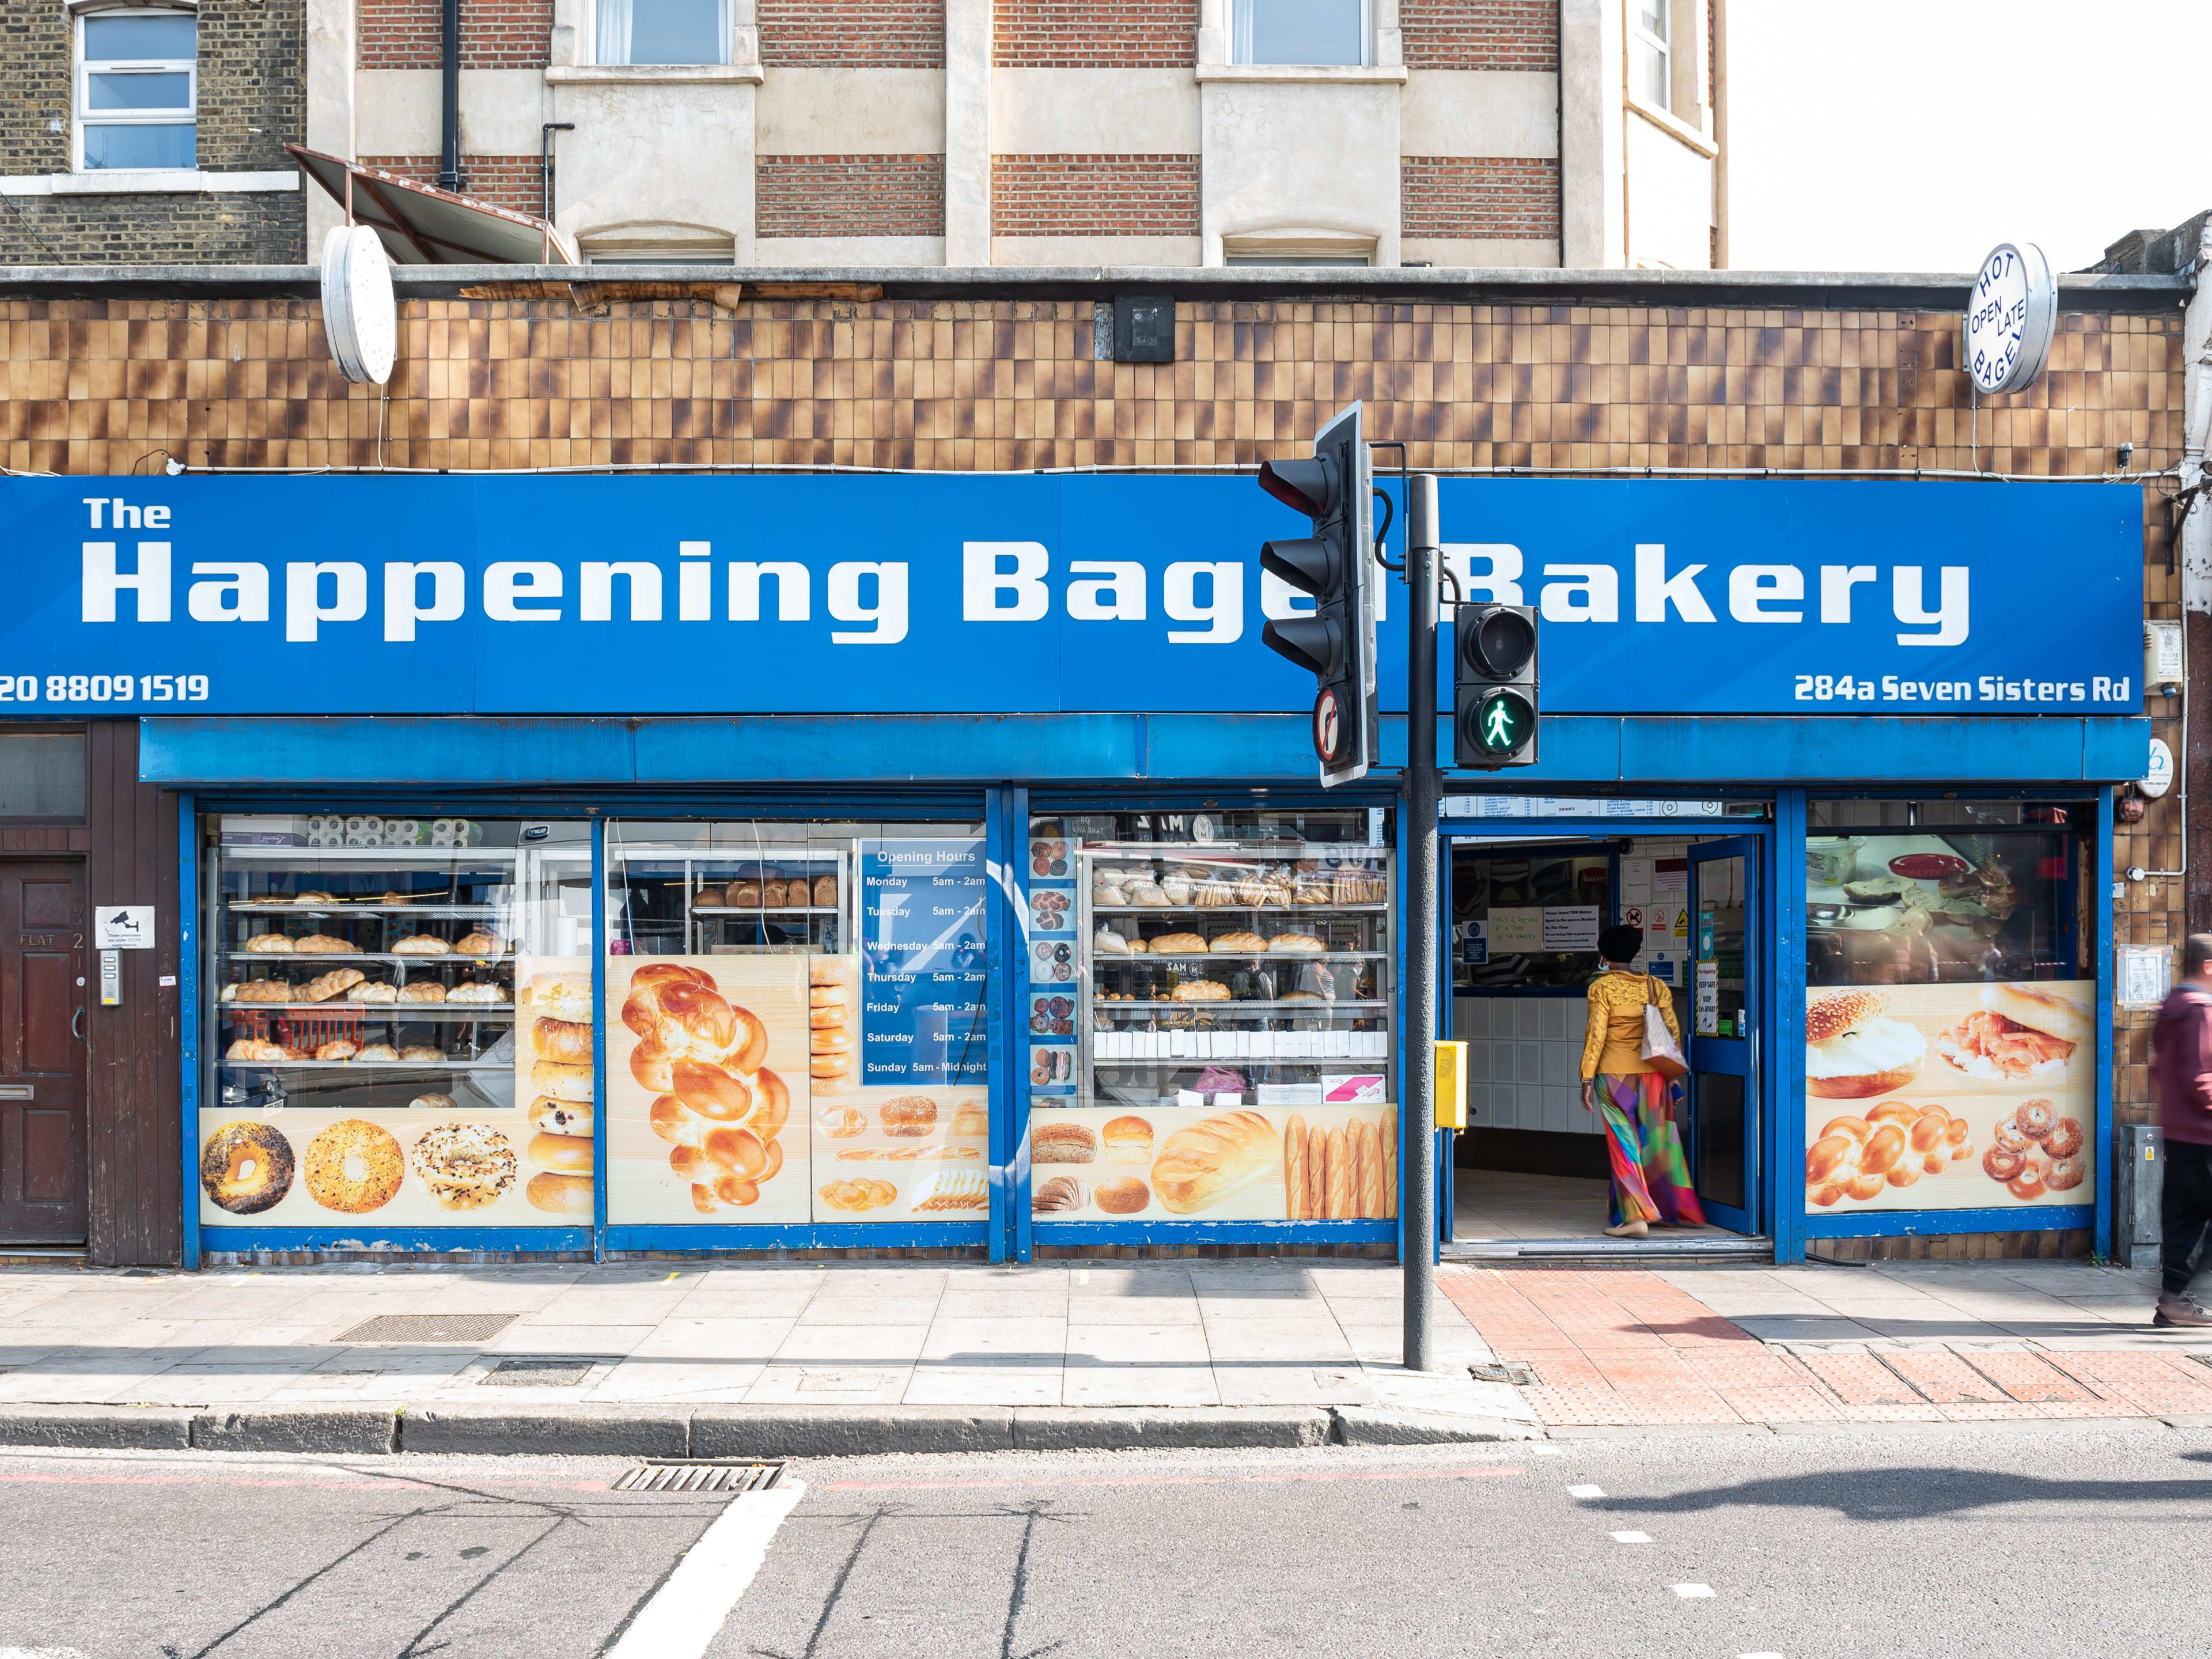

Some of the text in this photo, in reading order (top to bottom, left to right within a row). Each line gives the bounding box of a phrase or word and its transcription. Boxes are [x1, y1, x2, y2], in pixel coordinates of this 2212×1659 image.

[1979, 252, 2014, 297] HOT
[1972, 296, 2002, 334] OPEN
[1997, 298, 2025, 337] LATE
[1974, 324, 2023, 385] BAGEL
[82, 498, 172, 529] The
[82, 541, 909, 645] Happening
[1439, 543, 1969, 646] Bakery
[46, 675, 135, 702] 8809
[139, 675, 209, 701] 1519
[1794, 675, 2130, 702] 284a Seven Sisters Rd
[877, 850, 976, 864] Opening Hours
[866, 877, 908, 888] Monday
[932, 877, 955, 886] 5am
[964, 877, 986, 886] 2am
[73, 910, 83, 925] 3
[867, 907, 911, 918] Tuesday
[932, 906, 955, 916] 5am
[964, 906, 986, 916] 2am
[1512, 914, 1516, 924] 4
[1700, 919, 1713, 927] MASKS
[19, 933, 84, 949] FLAT 2
[867, 941, 928, 952] Wednesday
[932, 941, 955, 950] 5am
[964, 941, 986, 950] 2am
[867, 972, 916, 984] Thursday
[932, 972, 955, 982] 5am
[964, 972, 986, 982] 2am
[866, 1002, 900, 1014] Friday
[932, 1002, 955, 1012] 5am
[964, 1002, 986, 1012] 2am
[867, 1032, 914, 1044] Saturday
[932, 1032, 955, 1041] 5am
[964, 1032, 986, 1041] 2am
[867, 1062, 907, 1074] Sunday
[912, 1063, 934, 1071] 5am
[941, 1062, 987, 1074] Midnight
